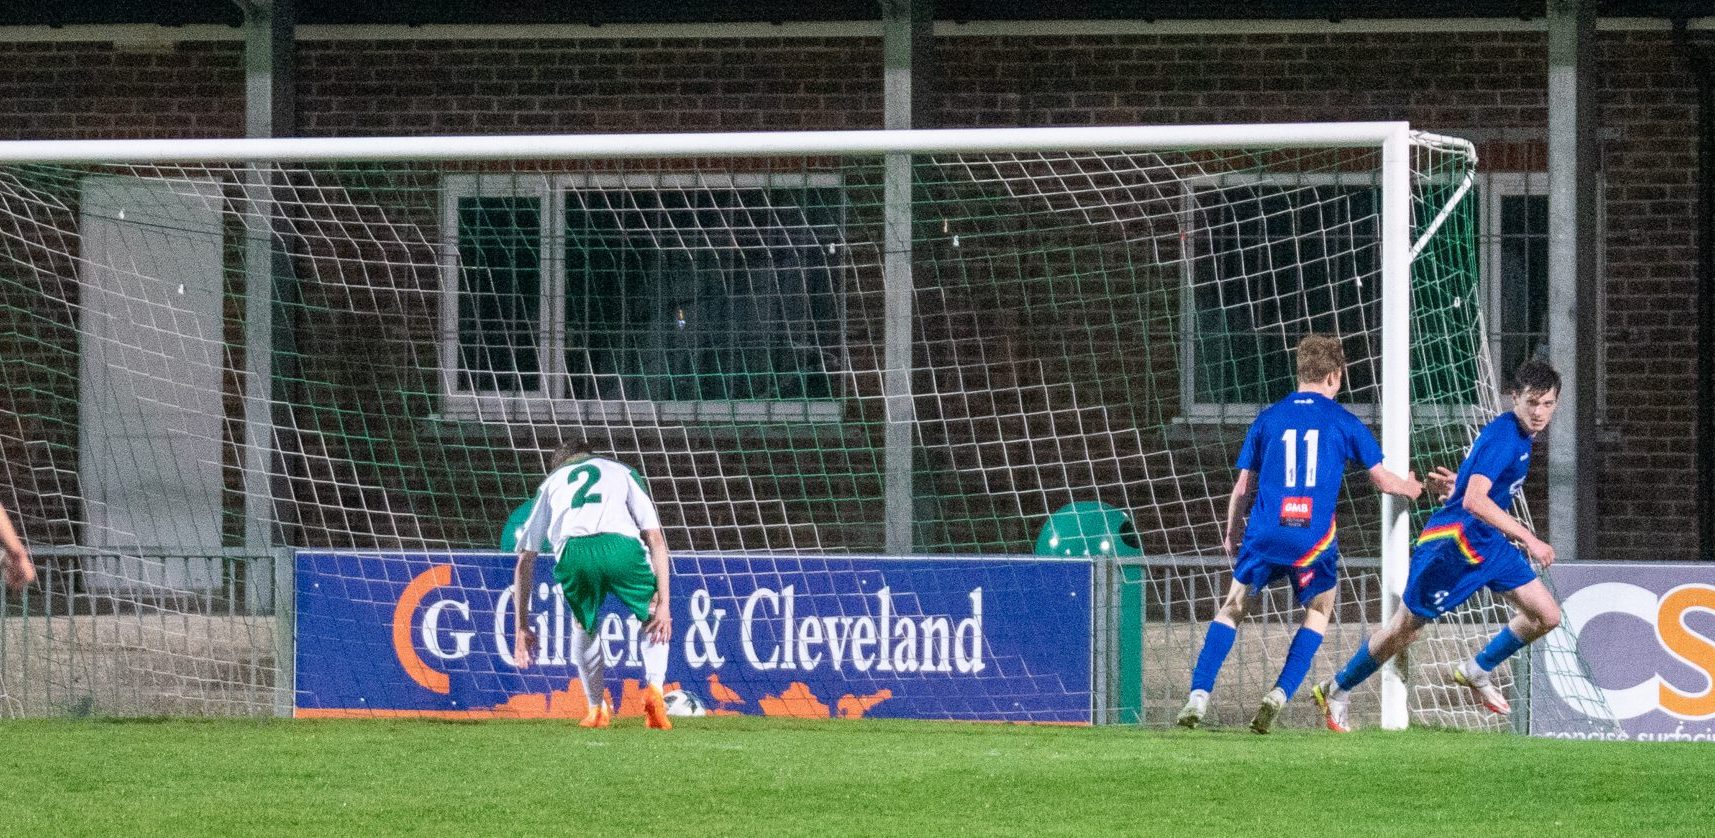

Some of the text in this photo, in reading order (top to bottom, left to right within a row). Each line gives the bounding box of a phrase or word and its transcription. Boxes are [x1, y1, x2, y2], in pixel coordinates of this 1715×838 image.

[1281, 428, 1320, 488] 11
[567, 463, 603, 509] 2
[1284, 502, 1309, 513] GMB
[494, 582, 986, 674] Giler & Cleveland
